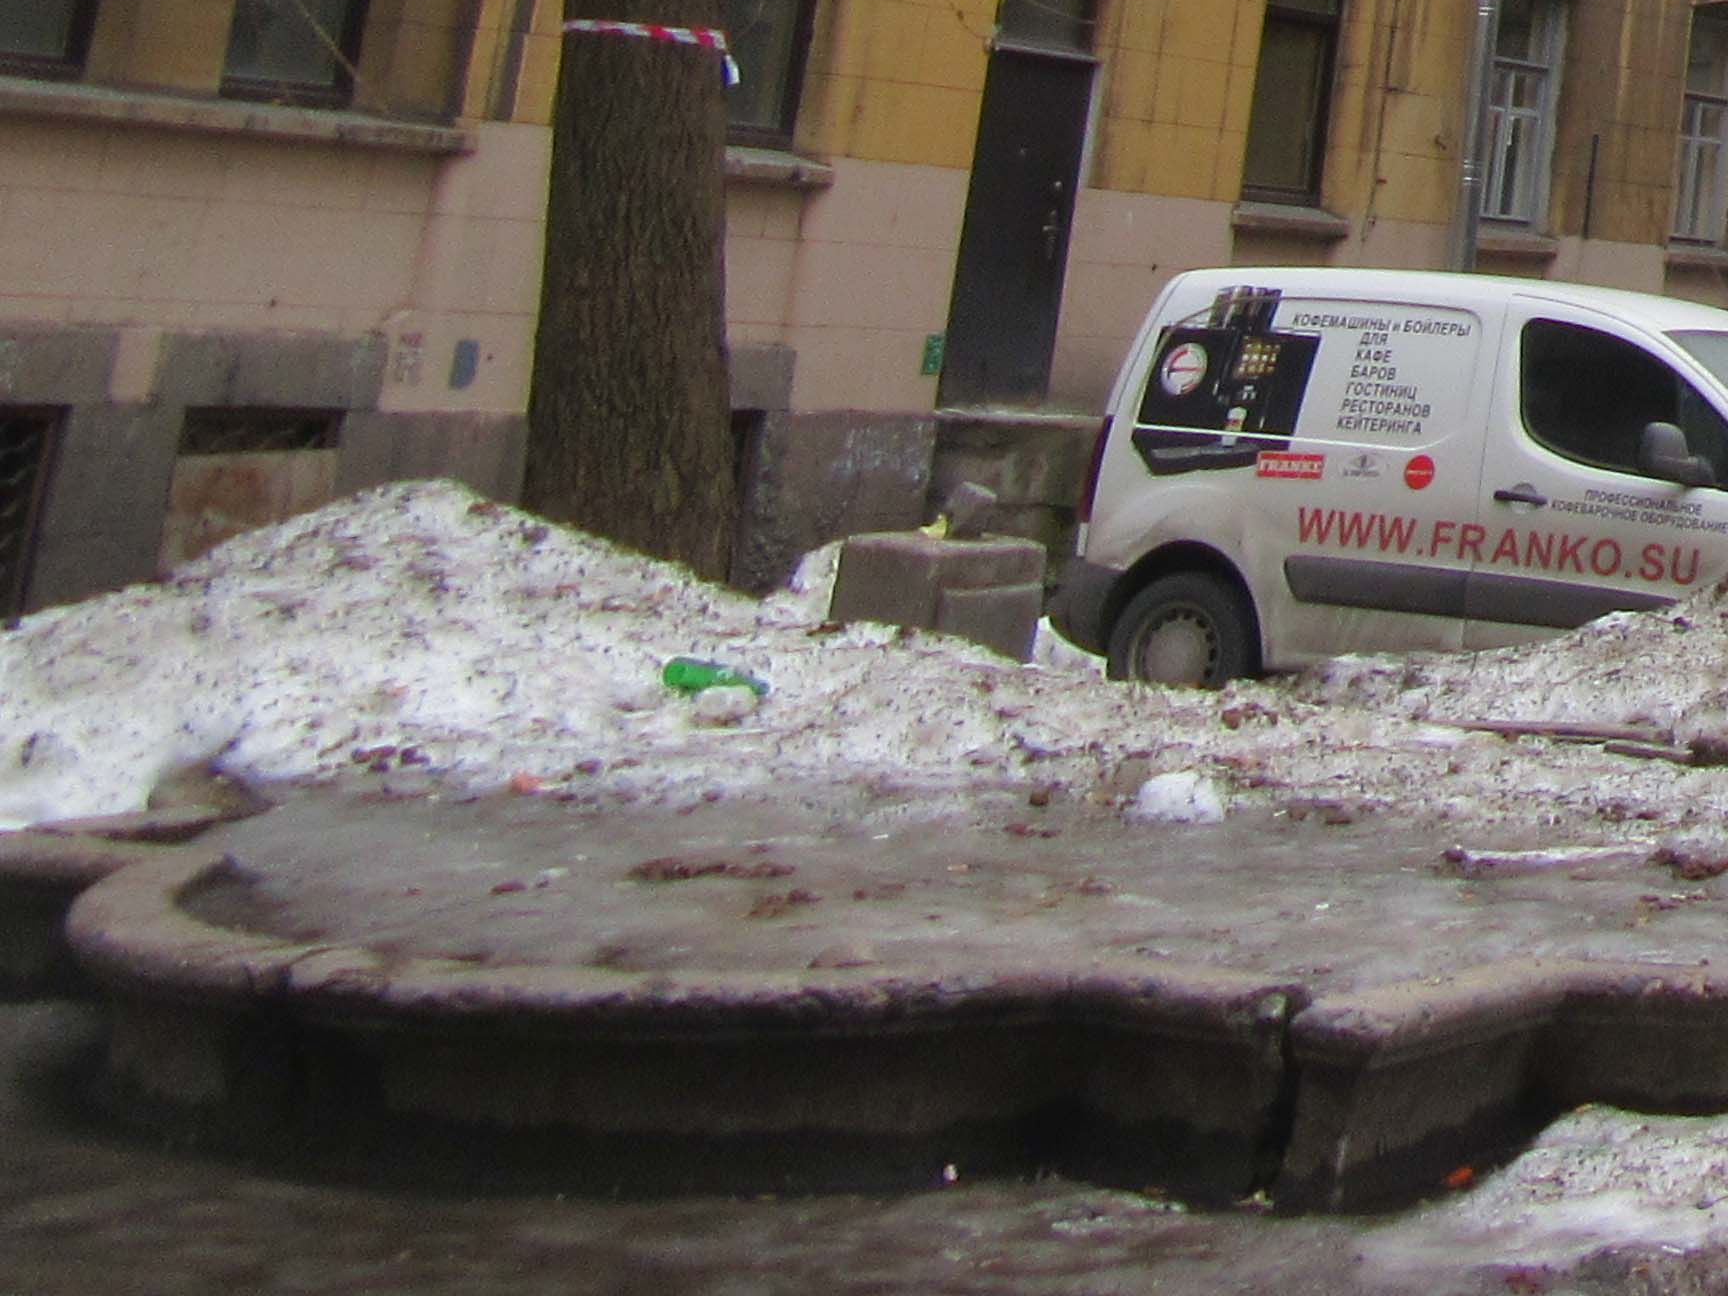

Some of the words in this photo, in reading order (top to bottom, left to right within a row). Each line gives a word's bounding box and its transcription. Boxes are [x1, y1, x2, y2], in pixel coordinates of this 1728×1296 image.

[1292, 313, 1391, 331] КОФЕМАШИНЫ
[1403, 319, 1472, 337] БОЙЛЕРЫ
[1359, 332, 1389, 346] ДЛЯ
[1355, 349, 1393, 363] КАФЕ
[1350, 365, 1397, 381] БАРОВ
[1345, 382, 1418, 400] ГОСТИНИЦ
[1341, 398, 1431, 418] РЕСТОРАНОВ
[1336, 414, 1422, 435] КЕЙТЕРИНГА
[1298, 507, 1700, 585] WWW.FRANKO.SU
